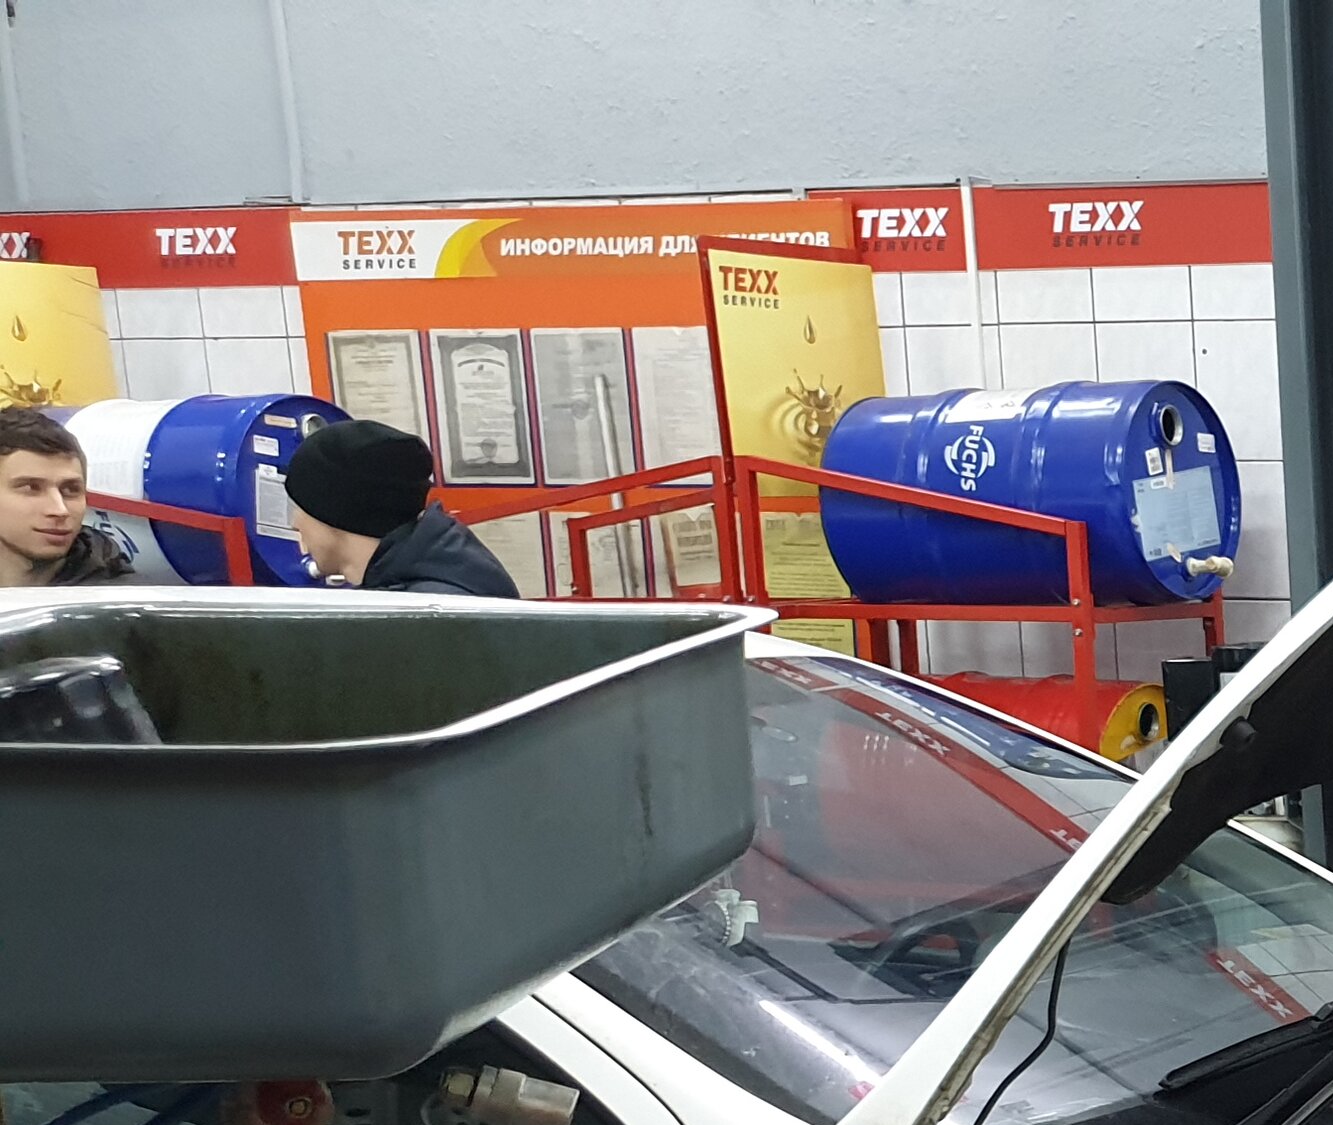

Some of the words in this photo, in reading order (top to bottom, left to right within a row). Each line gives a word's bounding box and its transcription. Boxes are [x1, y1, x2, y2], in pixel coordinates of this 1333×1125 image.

[857, 208, 948, 238] TEXX
[1049, 201, 1143, 232] TEXX
[156, 227, 236, 255] TEXX
[337, 230, 416, 256] TEXX
[500, 236, 653, 257] ИНФОРМАЦИЯ
[861, 239, 946, 253] SERVICE
[1052, 234, 1142, 248] SERVICE
[342, 258, 417, 271] SERVICE
[719, 265, 779, 296] TEXX
[723, 294, 780, 311] SERVICE
[959, 424, 985, 492] FUCHS
